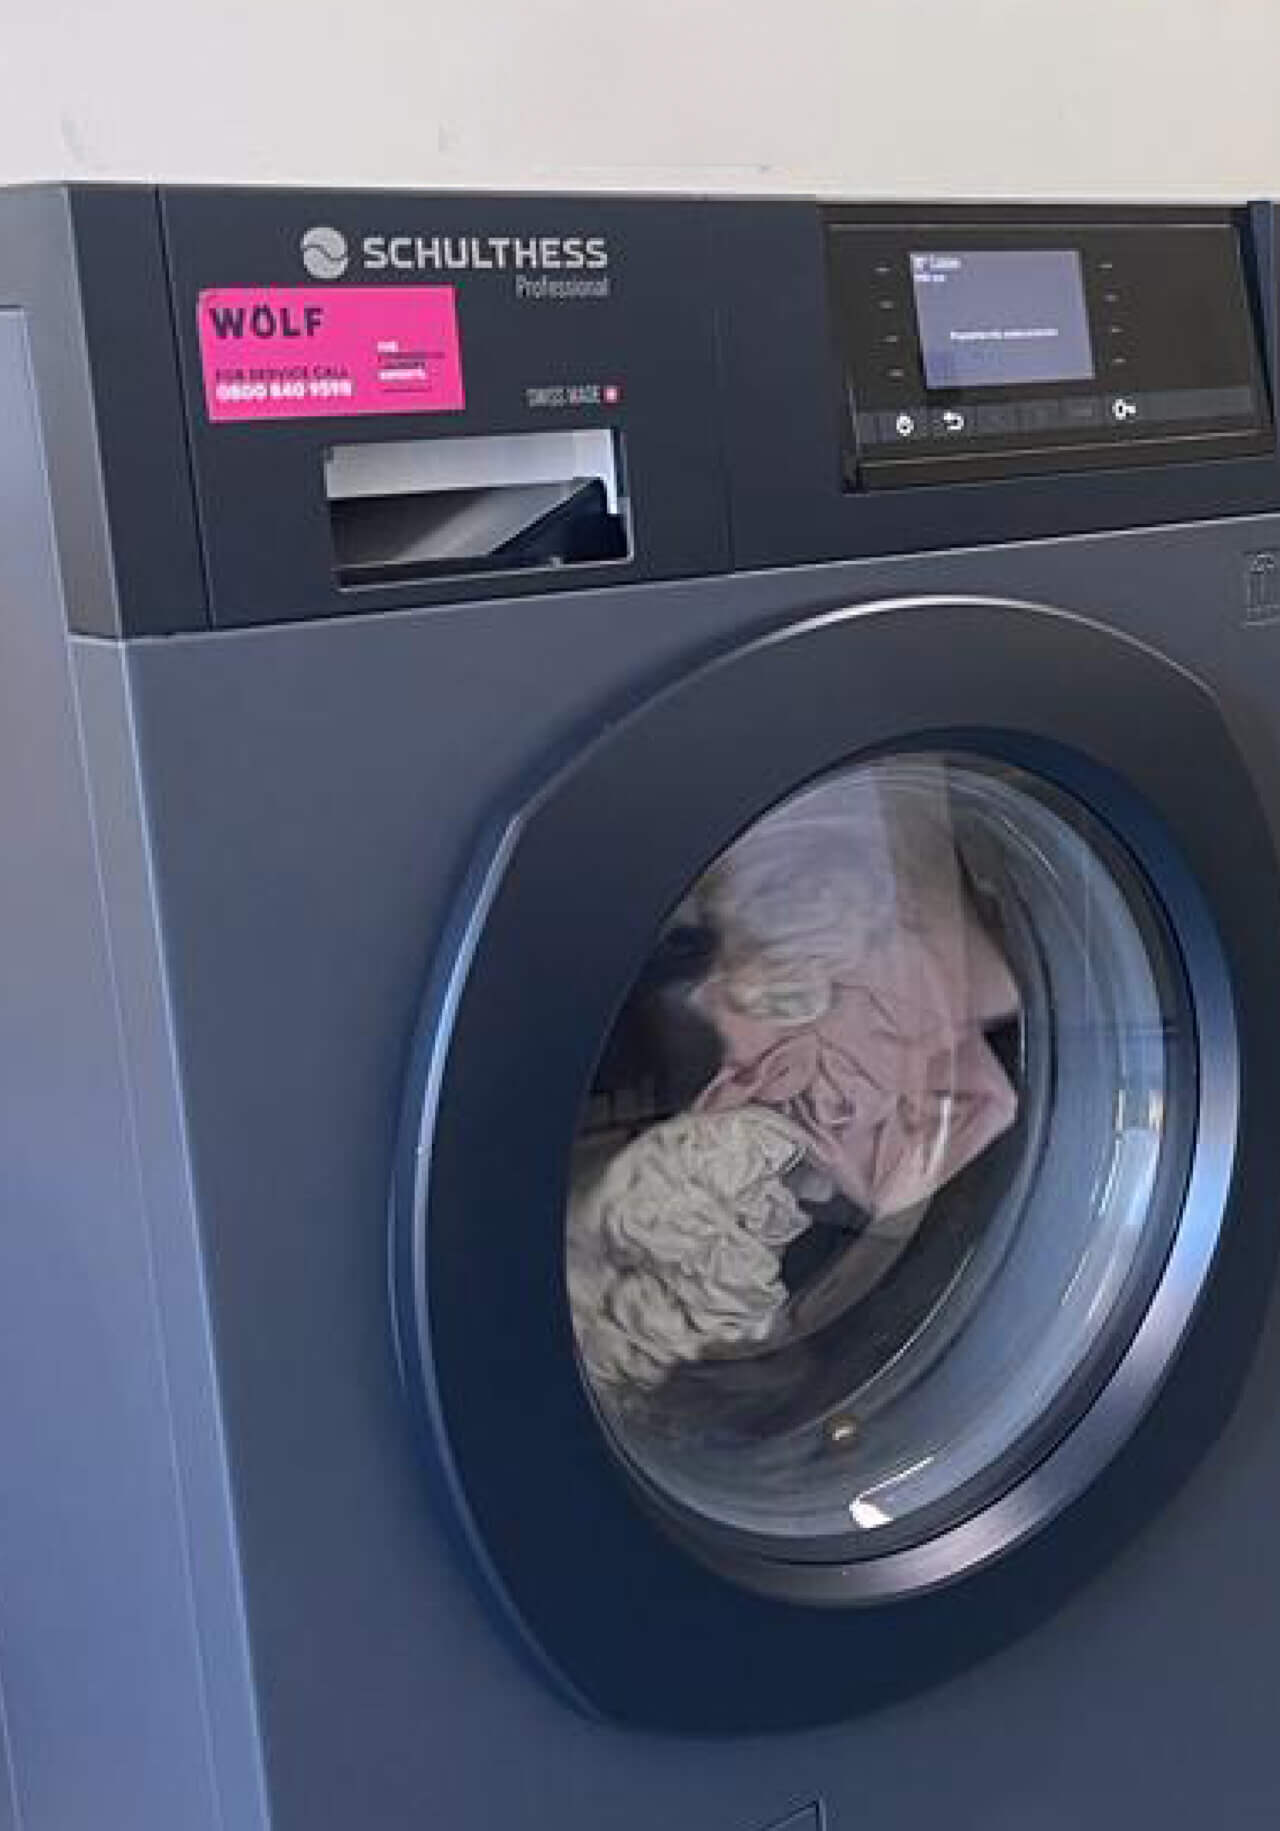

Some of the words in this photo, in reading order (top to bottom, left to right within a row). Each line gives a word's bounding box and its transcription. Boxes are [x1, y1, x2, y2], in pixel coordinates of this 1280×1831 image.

[363, 236, 608, 270] SCHULTHESS
[515, 273, 608, 300] Professional
[248, 365, 308, 382] SERVICE
[312, 363, 350, 379] CALL
